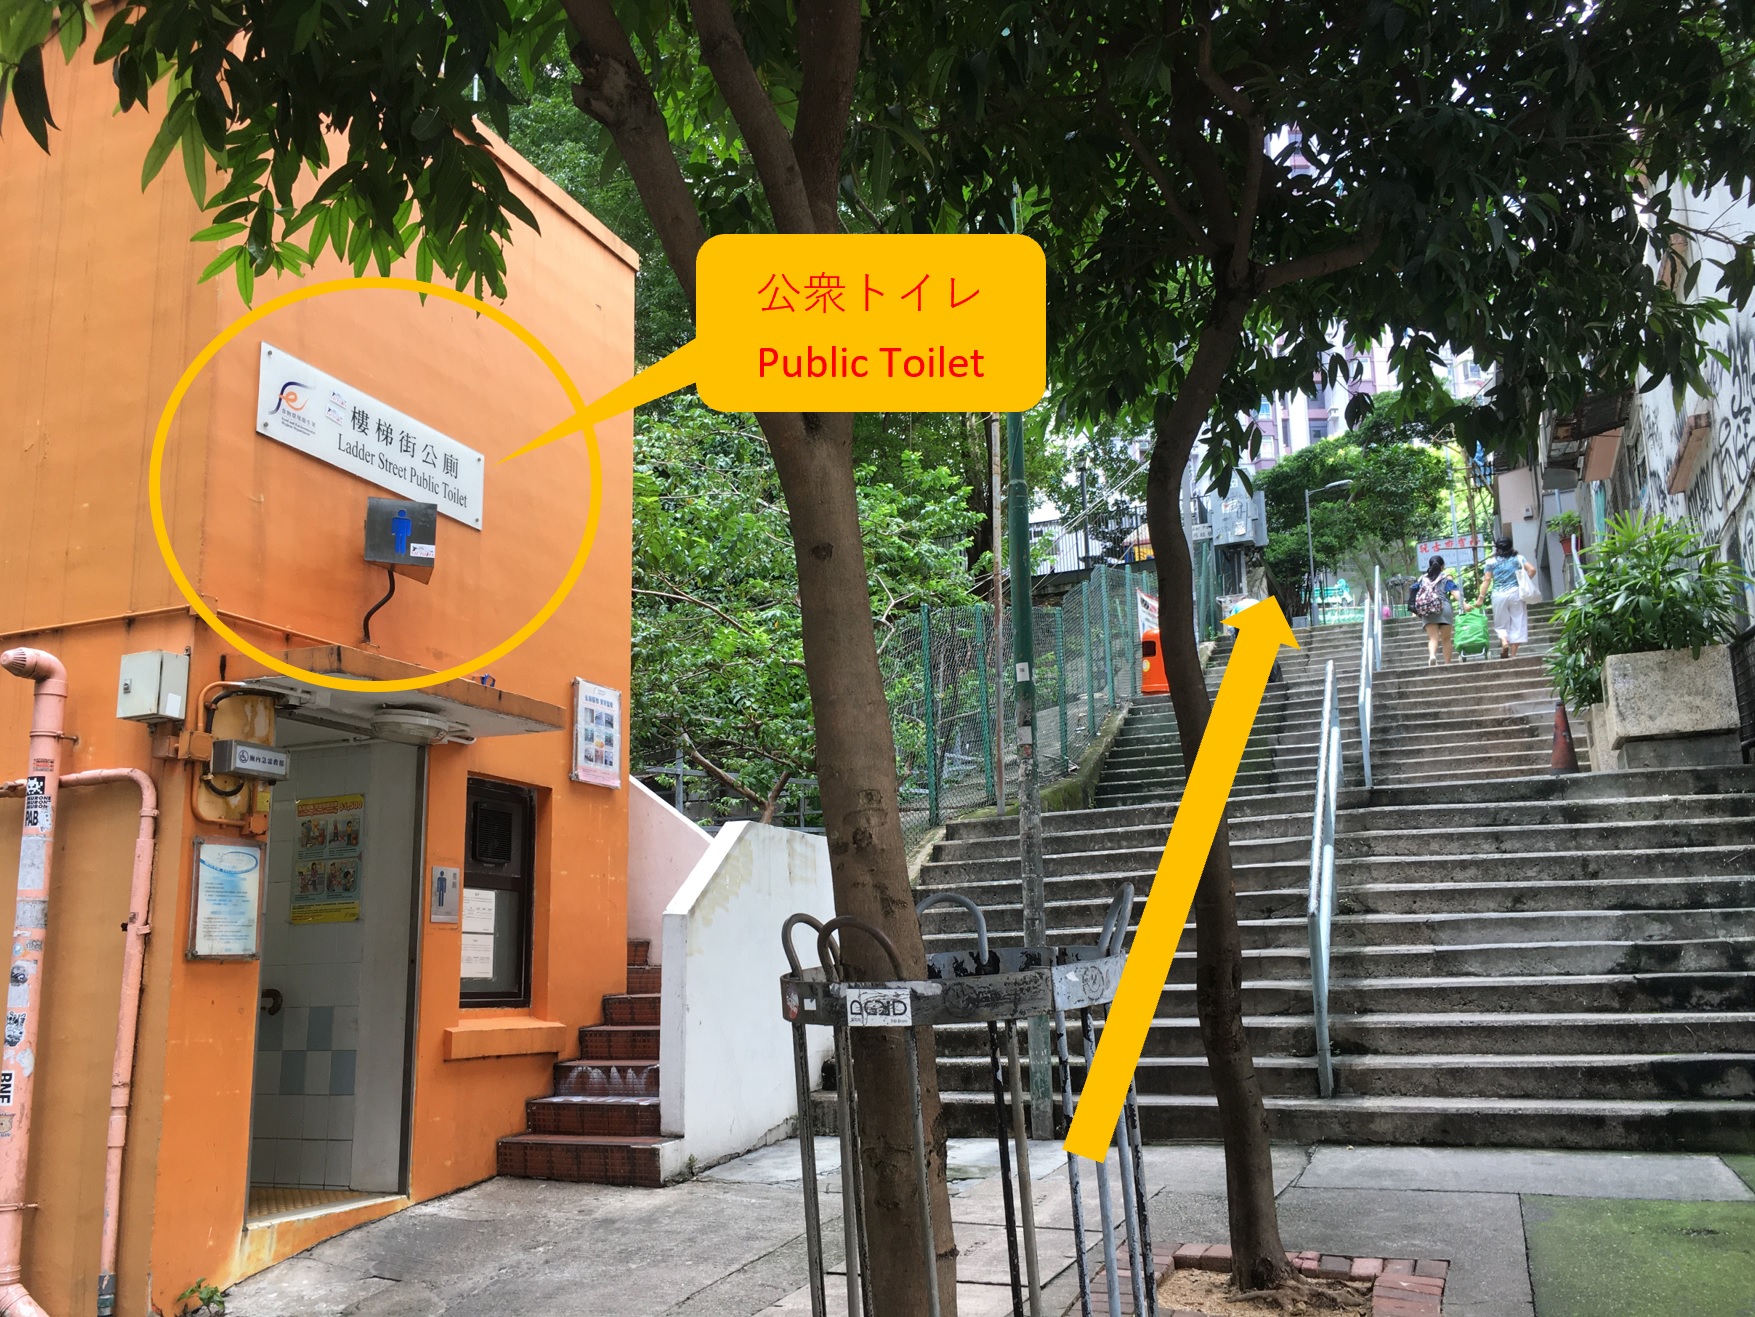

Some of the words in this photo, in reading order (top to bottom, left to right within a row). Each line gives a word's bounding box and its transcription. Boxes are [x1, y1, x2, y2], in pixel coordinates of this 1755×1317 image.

[338, 433, 376, 466] Ladder
[378, 452, 407, 481] Street
[409, 466, 440, 495] Public
[441, 481, 468, 508] Toilet
[350, 405, 459, 480] 樓梯街公廁
